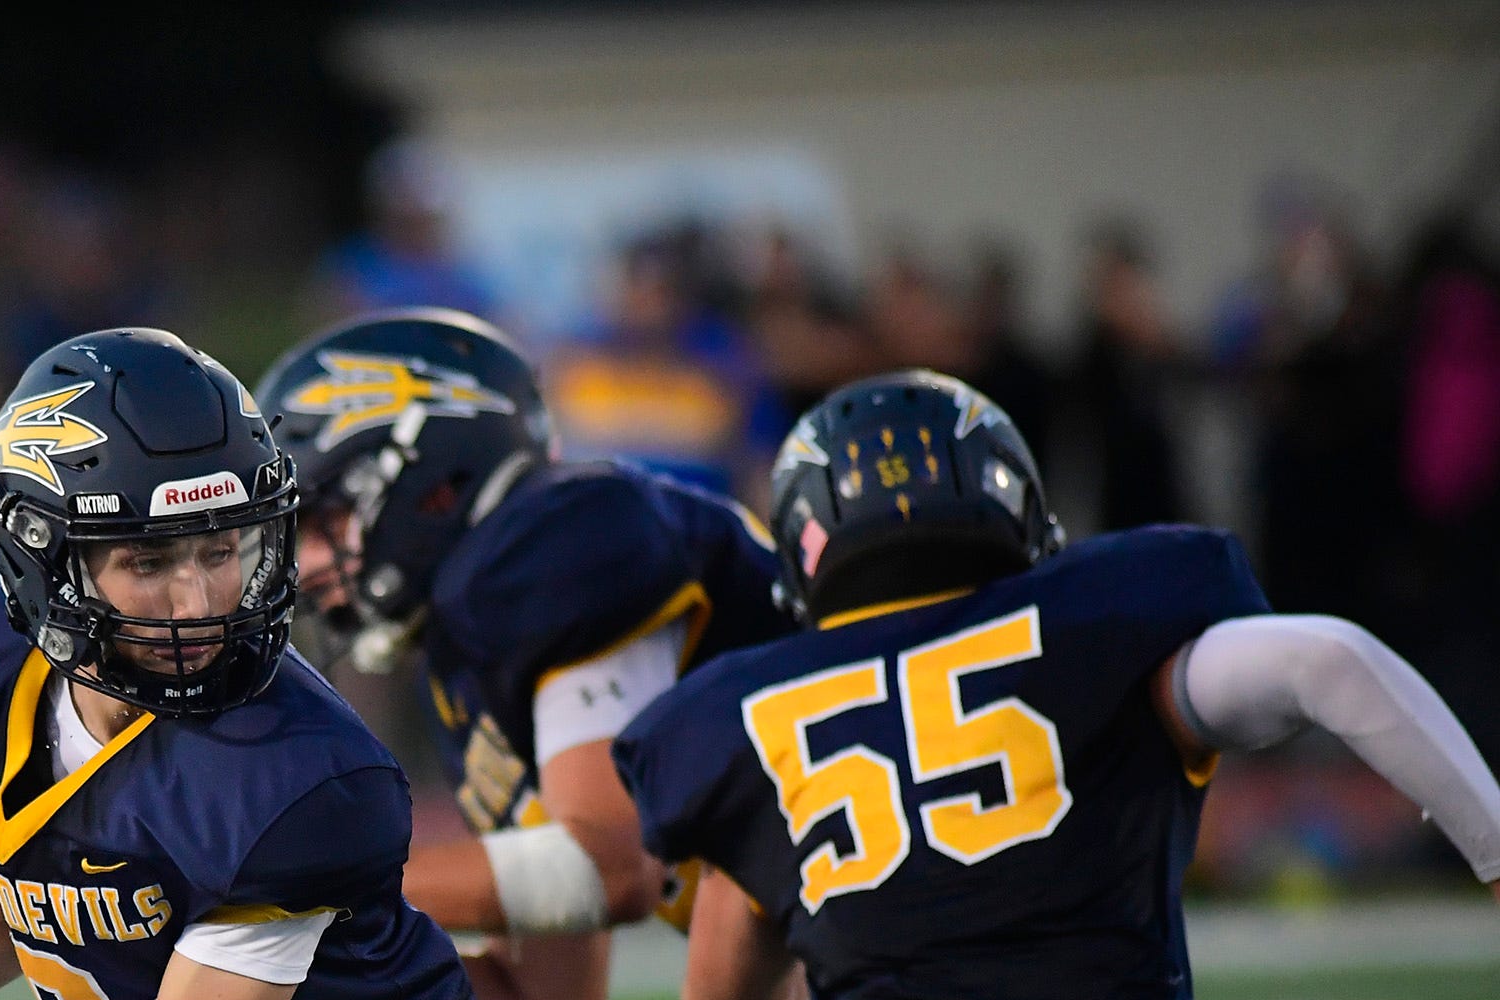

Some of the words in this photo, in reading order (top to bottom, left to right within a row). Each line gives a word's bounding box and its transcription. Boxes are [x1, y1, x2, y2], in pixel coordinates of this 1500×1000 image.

[76, 494, 120, 514] NXTRND
[165, 479, 235, 505] Riddell
[741, 604, 1072, 915] 55
